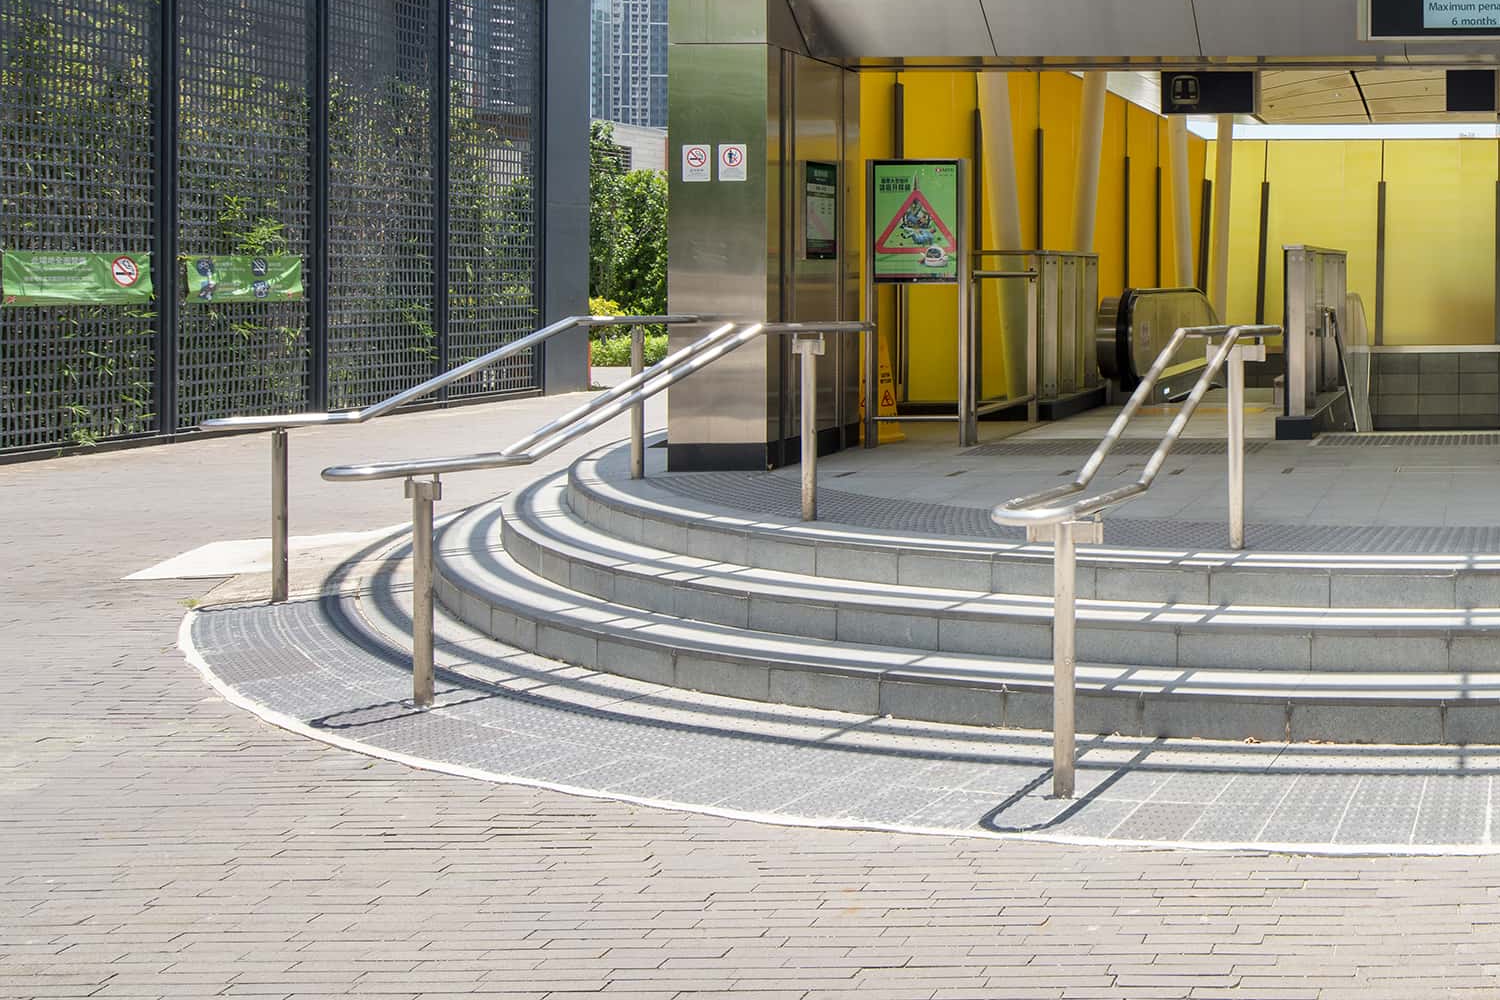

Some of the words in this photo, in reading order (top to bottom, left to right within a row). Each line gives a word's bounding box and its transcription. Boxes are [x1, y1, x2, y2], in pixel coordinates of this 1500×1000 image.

[1428, 2, 1476, 12] Maximum
[1451, 16, 1458, 26] 6
[1461, 15, 1497, 26] months
